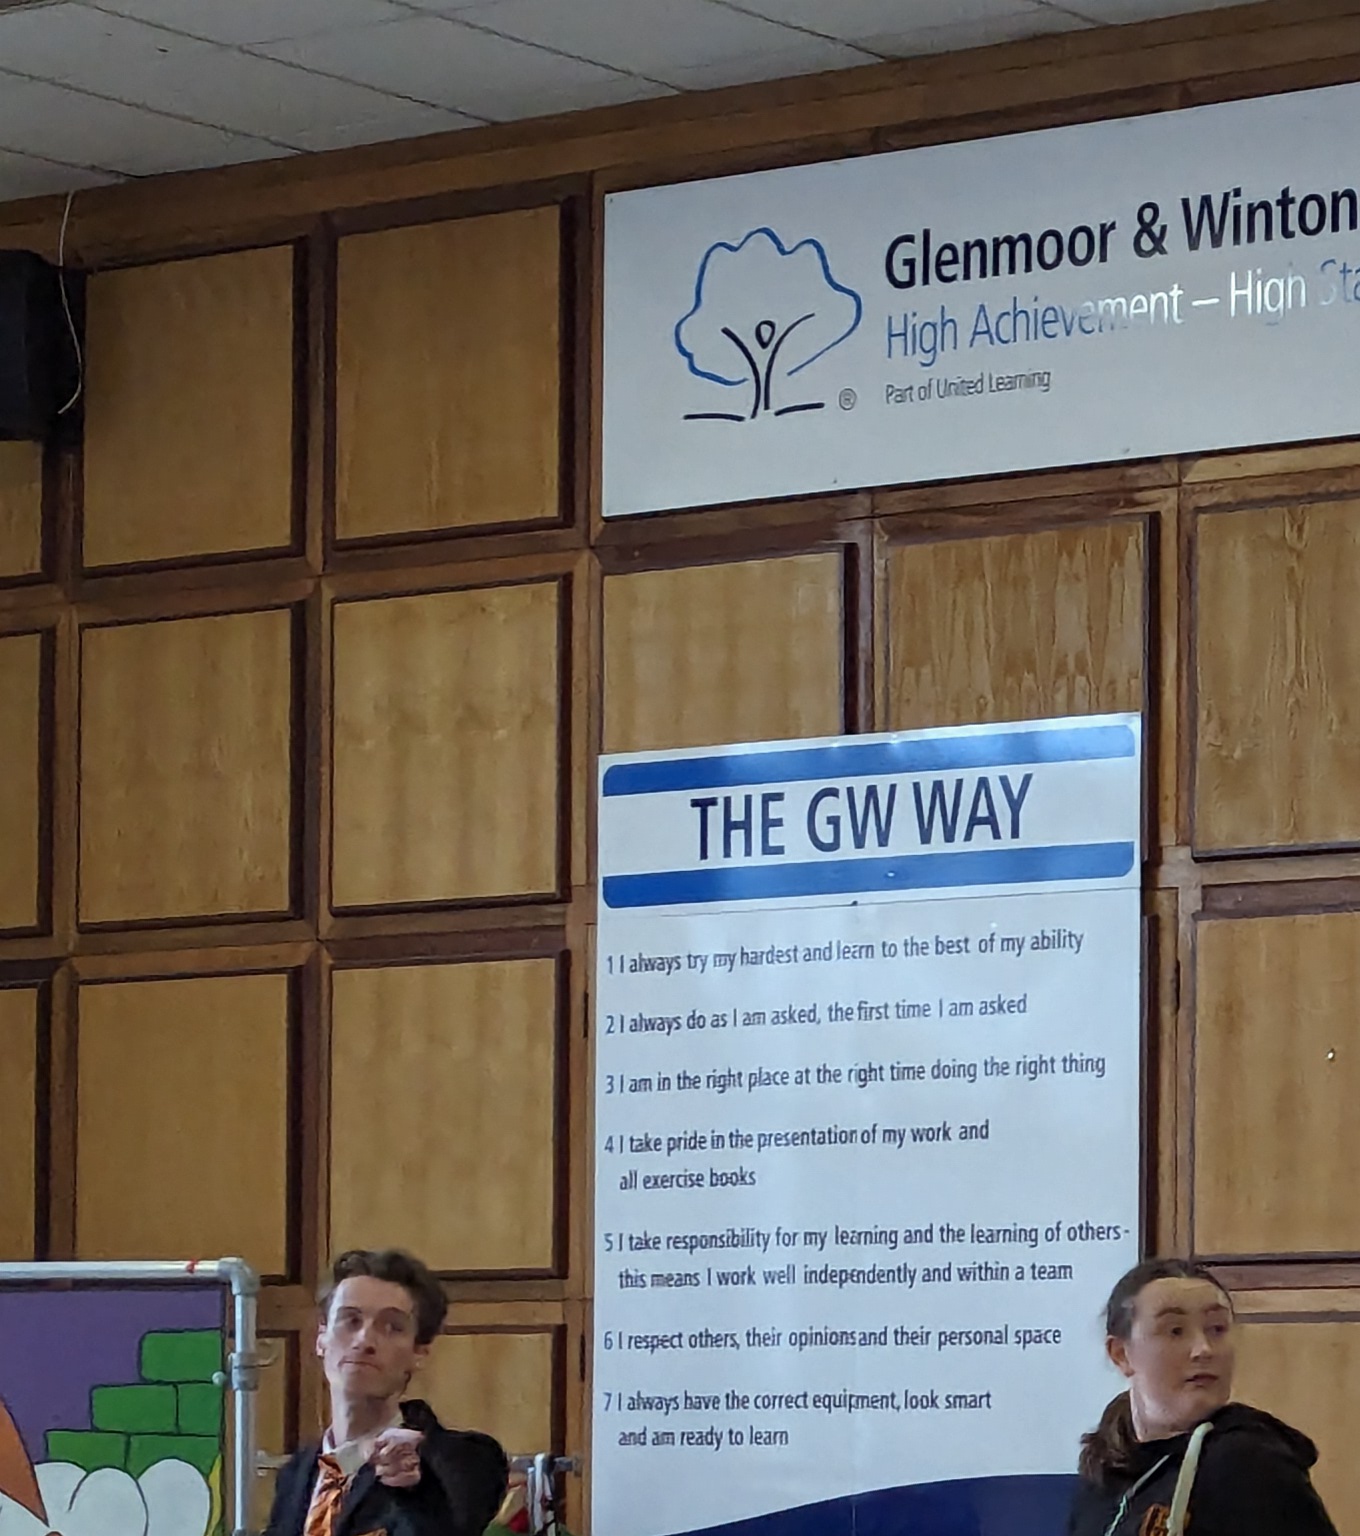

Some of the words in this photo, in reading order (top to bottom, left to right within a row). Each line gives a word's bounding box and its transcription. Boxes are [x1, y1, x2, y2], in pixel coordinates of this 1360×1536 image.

[884, 220, 1117, 290] Glenmoor
[1132, 201, 1169, 258] &
[1180, 185, 1358, 252] Winton
[887, 304, 958, 368] High
[969, 282, 1185, 348] Achievement
[1230, 261, 1307, 326] High
[886, 384, 914, 404] Part
[917, 378, 934, 400] of
[936, 371, 984, 399] United
[989, 368, 1052, 394] Learning
[690, 791, 786, 861] THE
[806, 782, 898, 853] GW
[912, 772, 1034, 846] WAY
[628, 952, 682, 976] always
[686, 953, 709, 974] try
[712, 952, 738, 973] my
[740, 944, 799, 967] hardest
[802, 940, 833, 963] and
[836, 940, 875, 960] learn
[881, 940, 898, 958] to
[903, 936, 930, 958] the
[934, 934, 971, 956] best
[978, 932, 996, 954] of
[1000, 936, 1026, 958] my
[1030, 928, 1084, 955] ability
[605, 1014, 616, 1035] 2
[628, 1012, 683, 1037] always
[686, 1008, 707, 1030] do
[710, 1012, 728, 1029] as
[742, 1011, 766, 1027] am
[770, 1002, 822, 1026] asked,
[827, 1001, 854, 1023] the
[856, 1000, 890, 1022] first
[894, 998, 932, 1020] time
[948, 1001, 974, 1017] am
[978, 992, 1028, 1016] asked
[605, 1074, 615, 1095] 3
[628, 1077, 653, 1094] am
[656, 1071, 672, 1092] in
[676, 1069, 702, 1091] the
[705, 1067, 743, 1095] right
[748, 1066, 790, 1094] place
[794, 1067, 811, 1086] at
[816, 1062, 843, 1084] the
[847, 1061, 885, 1089] right
[889, 1060, 926, 1082] time
[930, 1058, 978, 1084] doing
[983, 1055, 1010, 1077] the
[1015, 1053, 1056, 1082] right
[1061, 1052, 1106, 1079] thing
[604, 1135, 615, 1154] 4
[628, 1132, 663, 1154] take
[666, 1129, 708, 1158] pride
[710, 1129, 726, 1150] in
[728, 1128, 754, 1150] the
[757, 1124, 858, 1153] presentation
[860, 1122, 878, 1145] of
[882, 1127, 907, 1150] my
[909, 1120, 952, 1143] work
[958, 1118, 990, 1141] and
[619, 1169, 638, 1191] all
[642, 1168, 705, 1190] exercise
[709, 1165, 757, 1188] books
[604, 1232, 614, 1252] 5
[628, 1230, 662, 1252] take
[666, 1227, 771, 1256] responsibility
[775, 1226, 800, 1248] for
[803, 1230, 828, 1252] my
[834, 1224, 899, 1251] learning
[903, 1222, 934, 1245] and
[938, 1222, 966, 1244] the
[970, 1222, 1039, 1249] learning
[1044, 1220, 1062, 1243] of
[618, 1268, 648, 1290] this
[650, 1271, 701, 1288] means
[716, 1264, 757, 1287] work
[762, 1263, 796, 1285] well
[803, 1261, 917, 1290] independently
[921, 1261, 952, 1283] and
[956, 1260, 1010, 1282] within
[1014, 1265, 1025, 1281] a
[1029, 1262, 1075, 1281] team
[603, 1330, 614, 1351] 6
[627, 1331, 684, 1355] respect
[688, 1327, 741, 1351] others,
[745, 1326, 783, 1348] their
[788, 1325, 857, 1352] opinions
[858, 1325, 888, 1347] and
[893, 1325, 932, 1346] their
[937, 1323, 1009, 1352] personal
[1013, 1328, 1062, 1351] space
[603, 1392, 613, 1412] 7
[626, 1390, 680, 1417] always
[683, 1389, 721, 1411] have
[724, 1389, 750, 1411] the
[753, 1390, 809, 1410] correct
[812, 1387, 902, 1415] equipment,
[903, 1388, 940, 1410] look
[944, 1391, 992, 1410] smart
[617, 1425, 648, 1447] and
[651, 1431, 676, 1447] am
[679, 1425, 724, 1452] ready
[727, 1427, 745, 1446] to
[749, 1424, 789, 1446] learn
